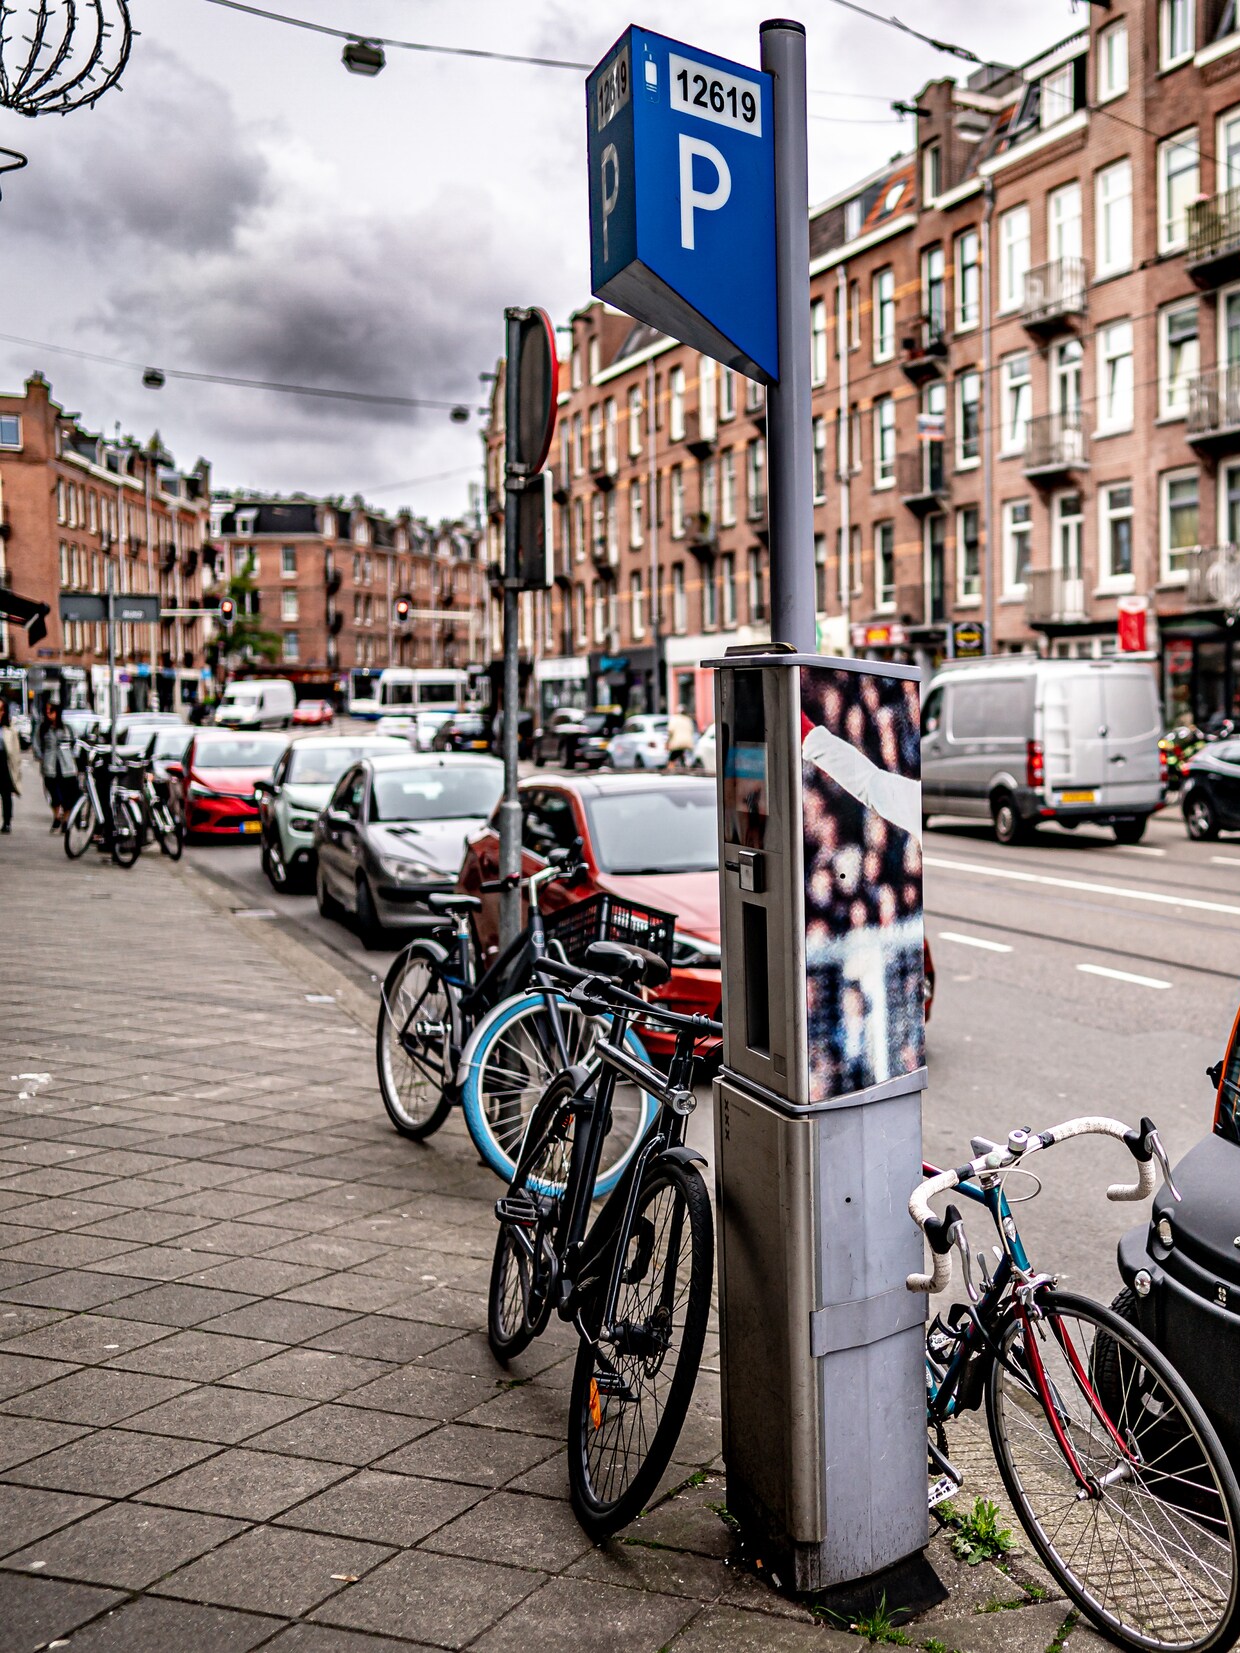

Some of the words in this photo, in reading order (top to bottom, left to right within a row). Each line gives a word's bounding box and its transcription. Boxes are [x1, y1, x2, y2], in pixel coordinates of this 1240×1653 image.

[676, 69, 756, 123] 12619
[601, 143, 619, 263] P
[678, 133, 732, 250] P
